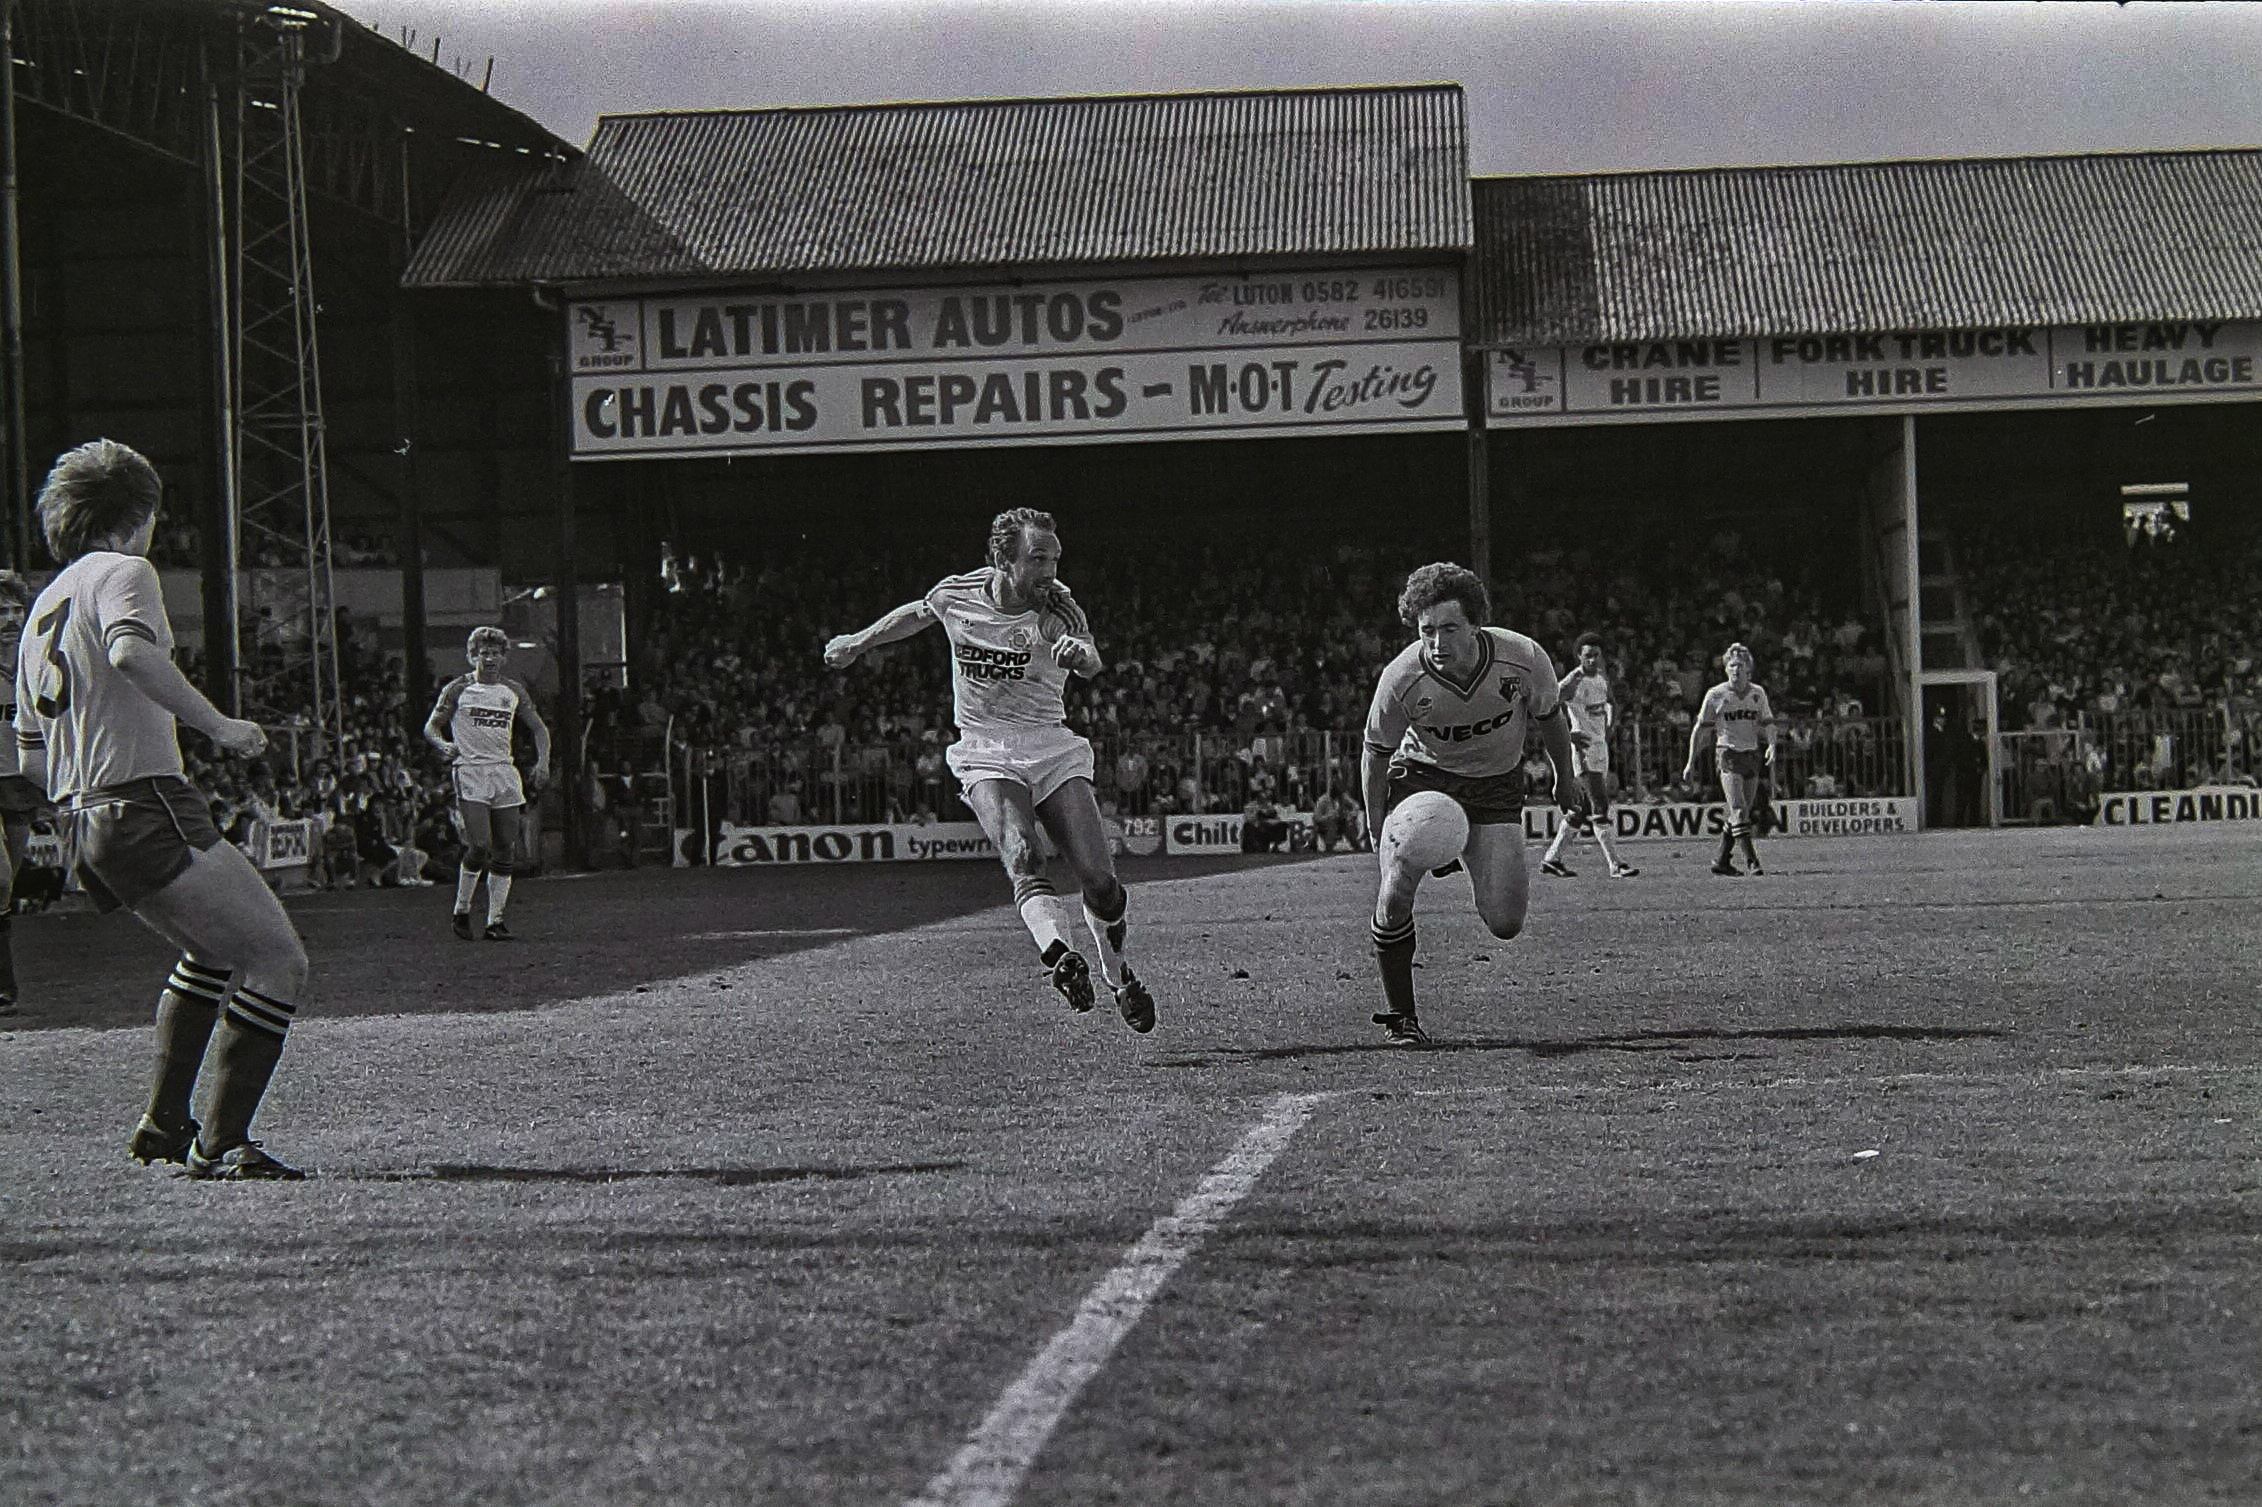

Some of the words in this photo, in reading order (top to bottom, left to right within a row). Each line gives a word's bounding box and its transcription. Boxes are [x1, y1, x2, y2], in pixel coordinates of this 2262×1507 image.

[1233, 283, 1293, 305] LUTON
[1303, 281, 1359, 302] 0582
[659, 302, 912, 358] LATIMER
[933, 290, 1124, 348] AUTOS
[1363, 308, 1428, 330] 26139
[2085, 322, 2222, 352] HEAVY
[580, 354, 634, 367] GROUP
[1582, 340, 1741, 370] CRANE
[1846, 367, 1948, 395] HIRE
[2066, 356, 2253, 389] HAULAGE
[584, 380, 818, 438] CHASSIS
[861, 367, 1127, 427] REPAIRS
[1304, 359, 1438, 415] Testing
[1611, 375, 1720, 404] HIRE
[1617, 804, 1788, 838] DAWSN
[1799, 802, 1880, 816] BUILDERS
[1173, 821, 1240, 845] Chilt
[1799, 817, 1904, 834] DEVELOPERS
